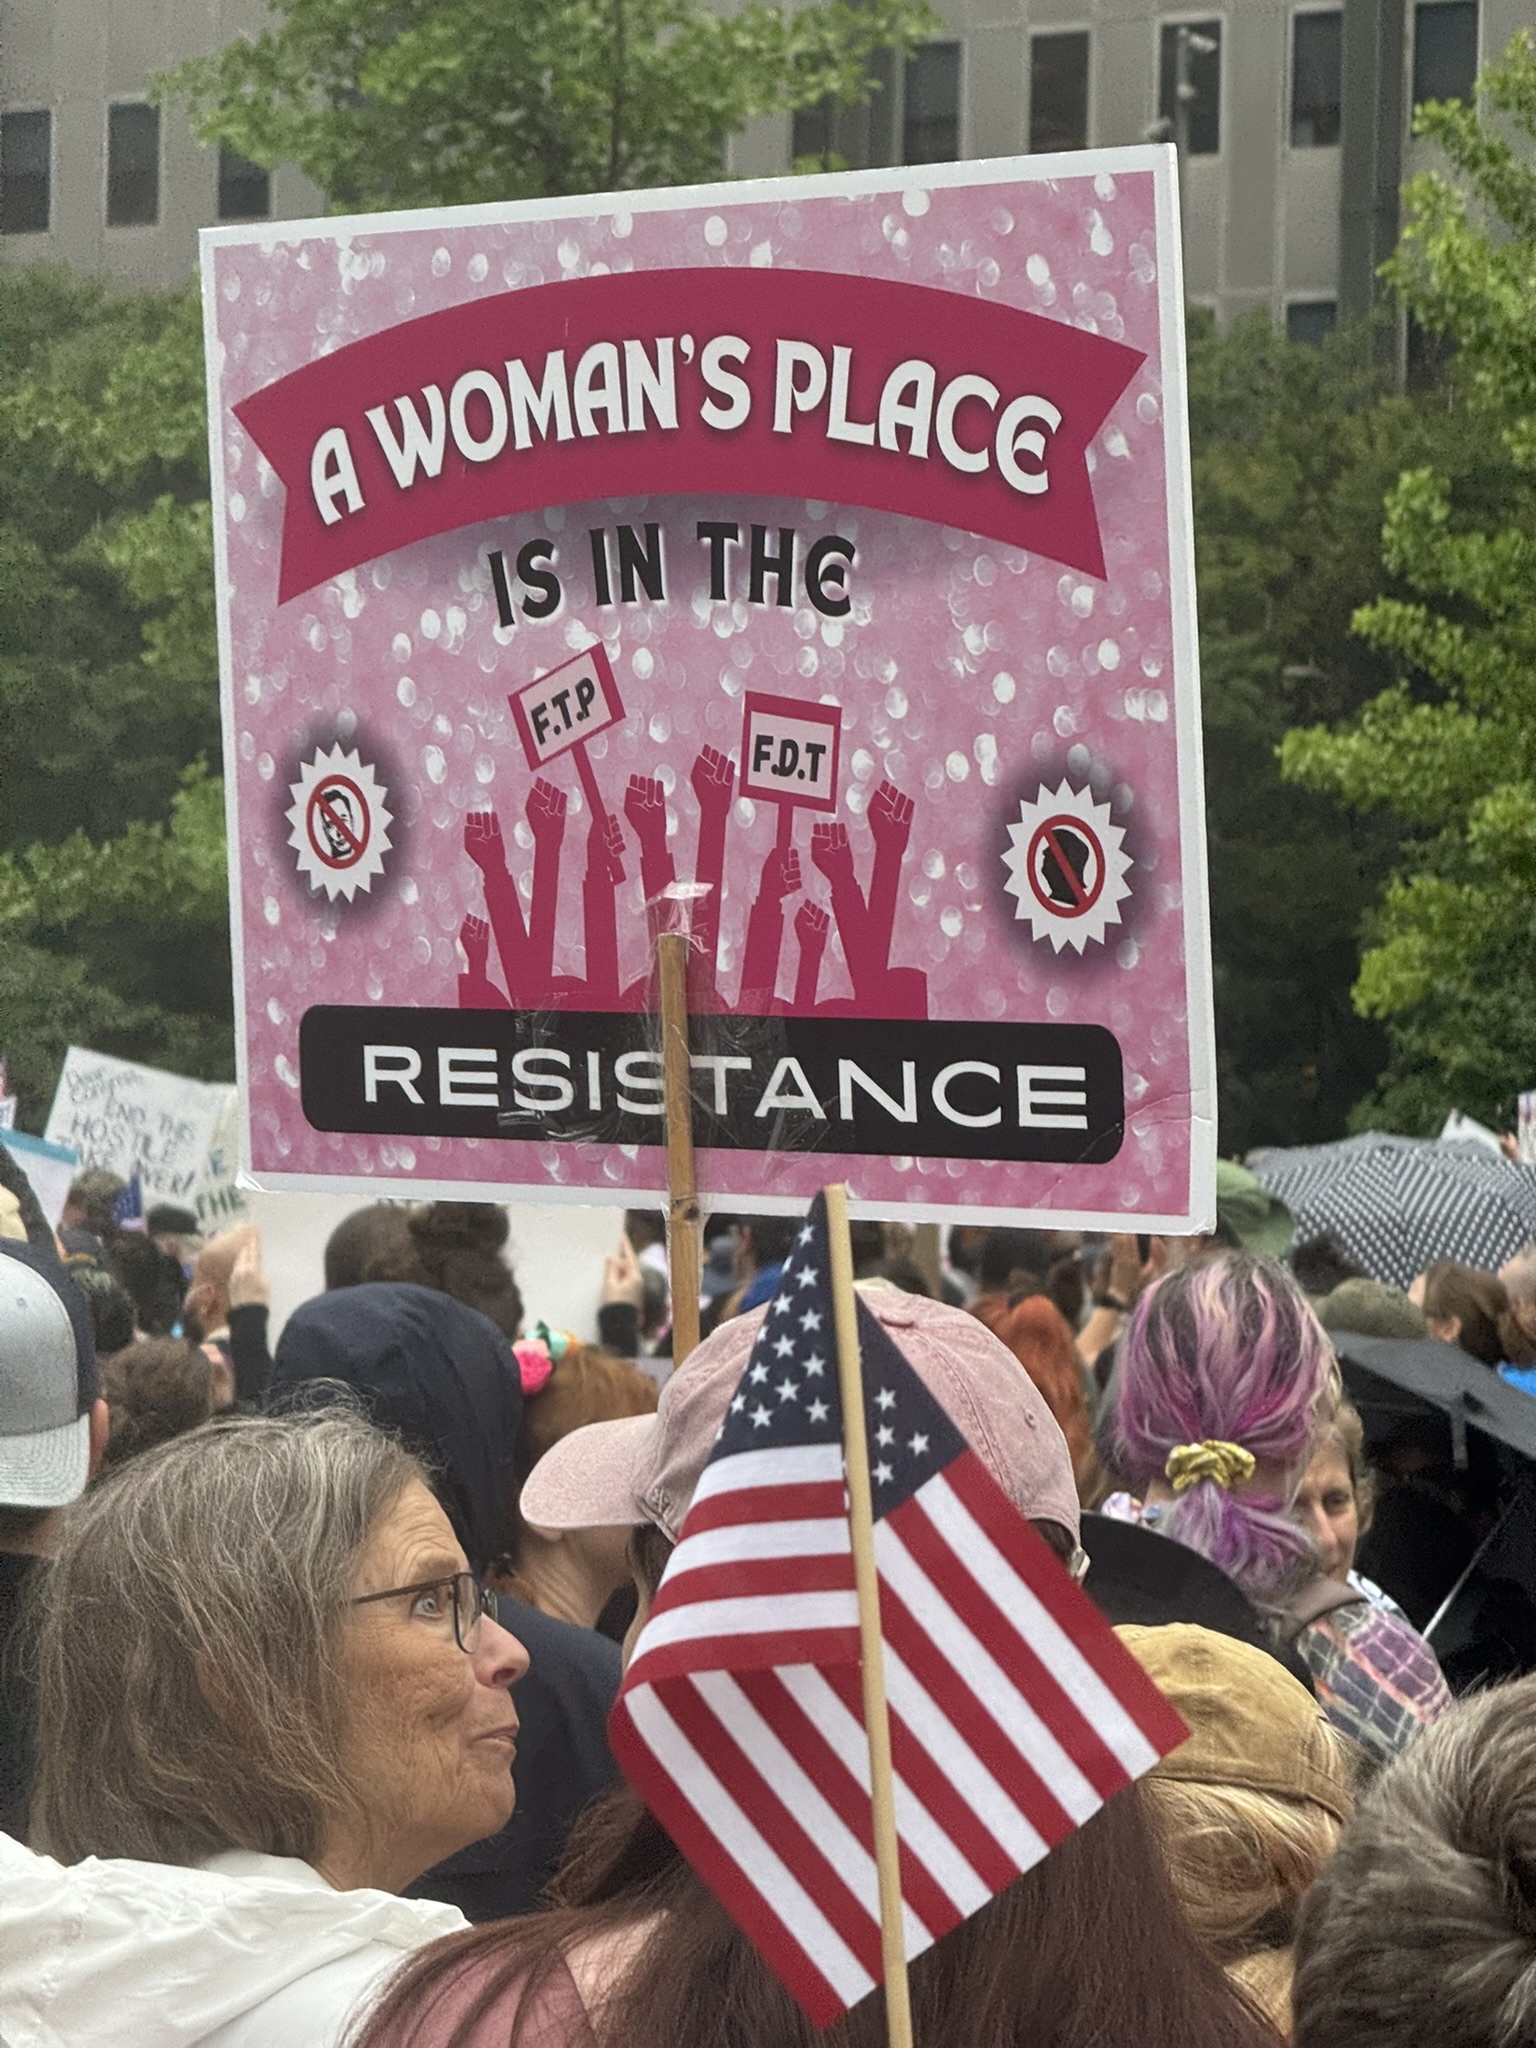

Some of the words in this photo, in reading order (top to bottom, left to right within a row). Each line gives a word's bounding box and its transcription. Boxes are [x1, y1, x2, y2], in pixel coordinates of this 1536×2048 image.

[311, 427, 366, 526] A
[364, 333, 752, 490] WOMAN'S
[772, 338, 1062, 495] PLACE
[487, 538, 562, 629] IS
[588, 522, 666, 608] IN
[696, 521, 857, 618] THE
[530, 676, 596, 746] F.T.P
[753, 733, 827, 783] F.D.T
[363, 1044, 1089, 1130] RESISTANCE
